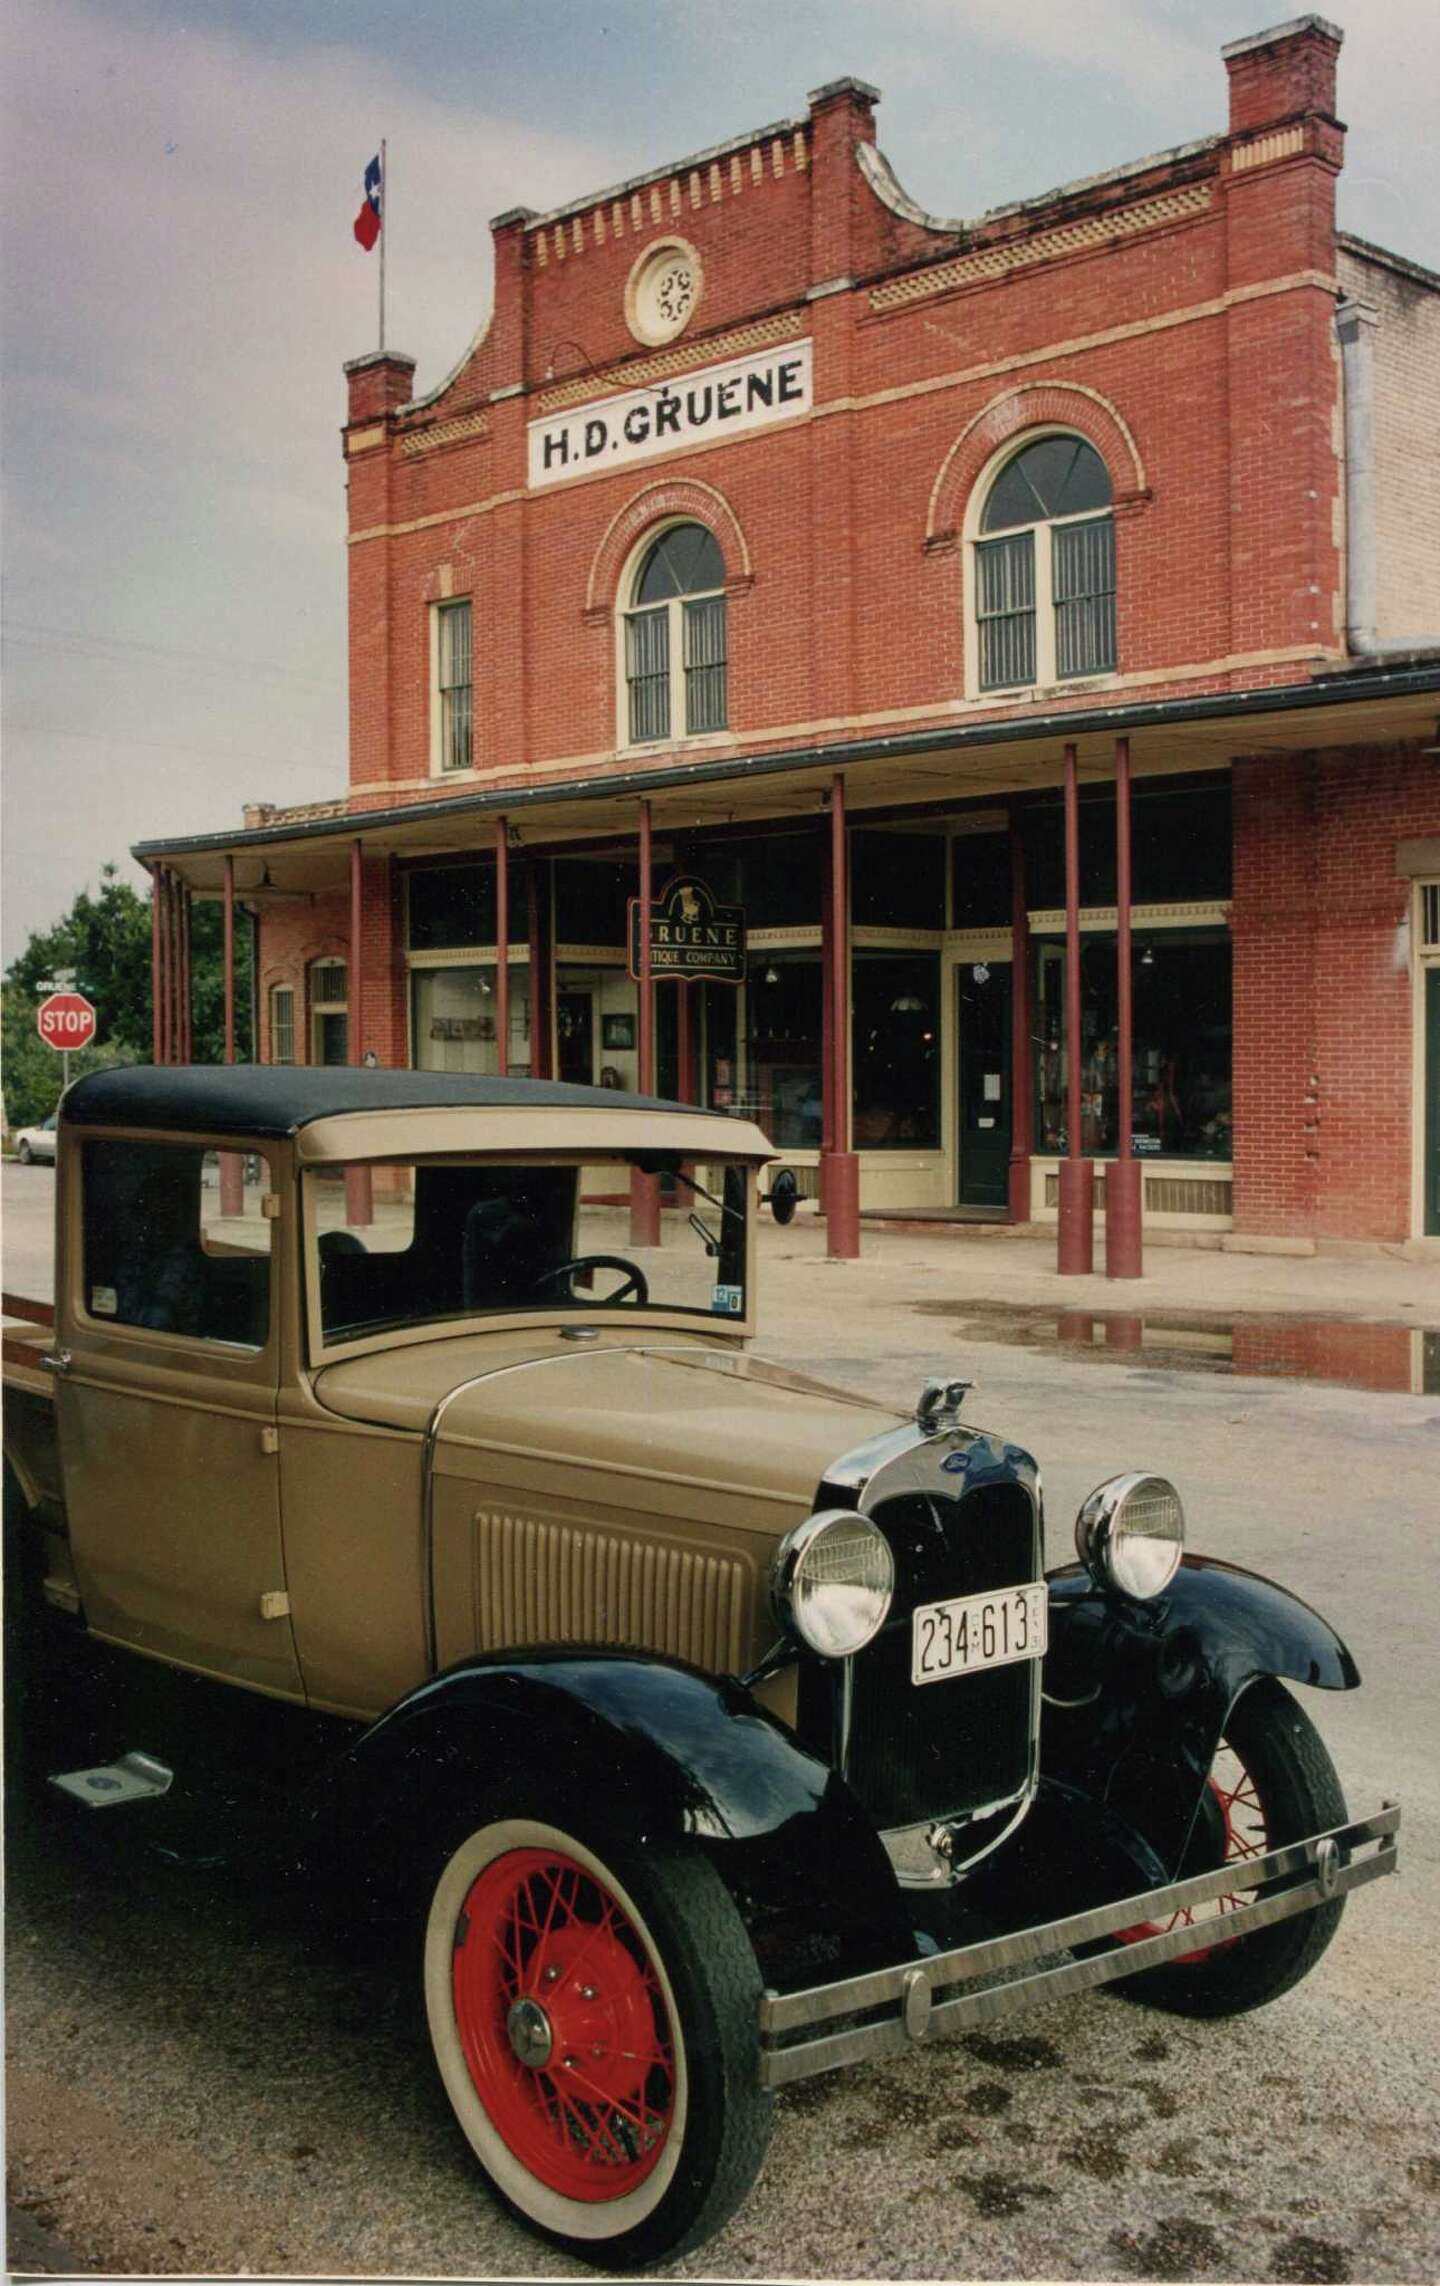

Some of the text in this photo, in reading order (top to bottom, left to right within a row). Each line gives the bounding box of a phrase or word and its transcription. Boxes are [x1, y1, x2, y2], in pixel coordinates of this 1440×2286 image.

[623, 360, 803, 444] GRUENE
[650, 925, 737, 945] RUENE
[651, 950, 736, 966] TIQUE COMPANY
[43, 1011, 91, 1032] STOP
